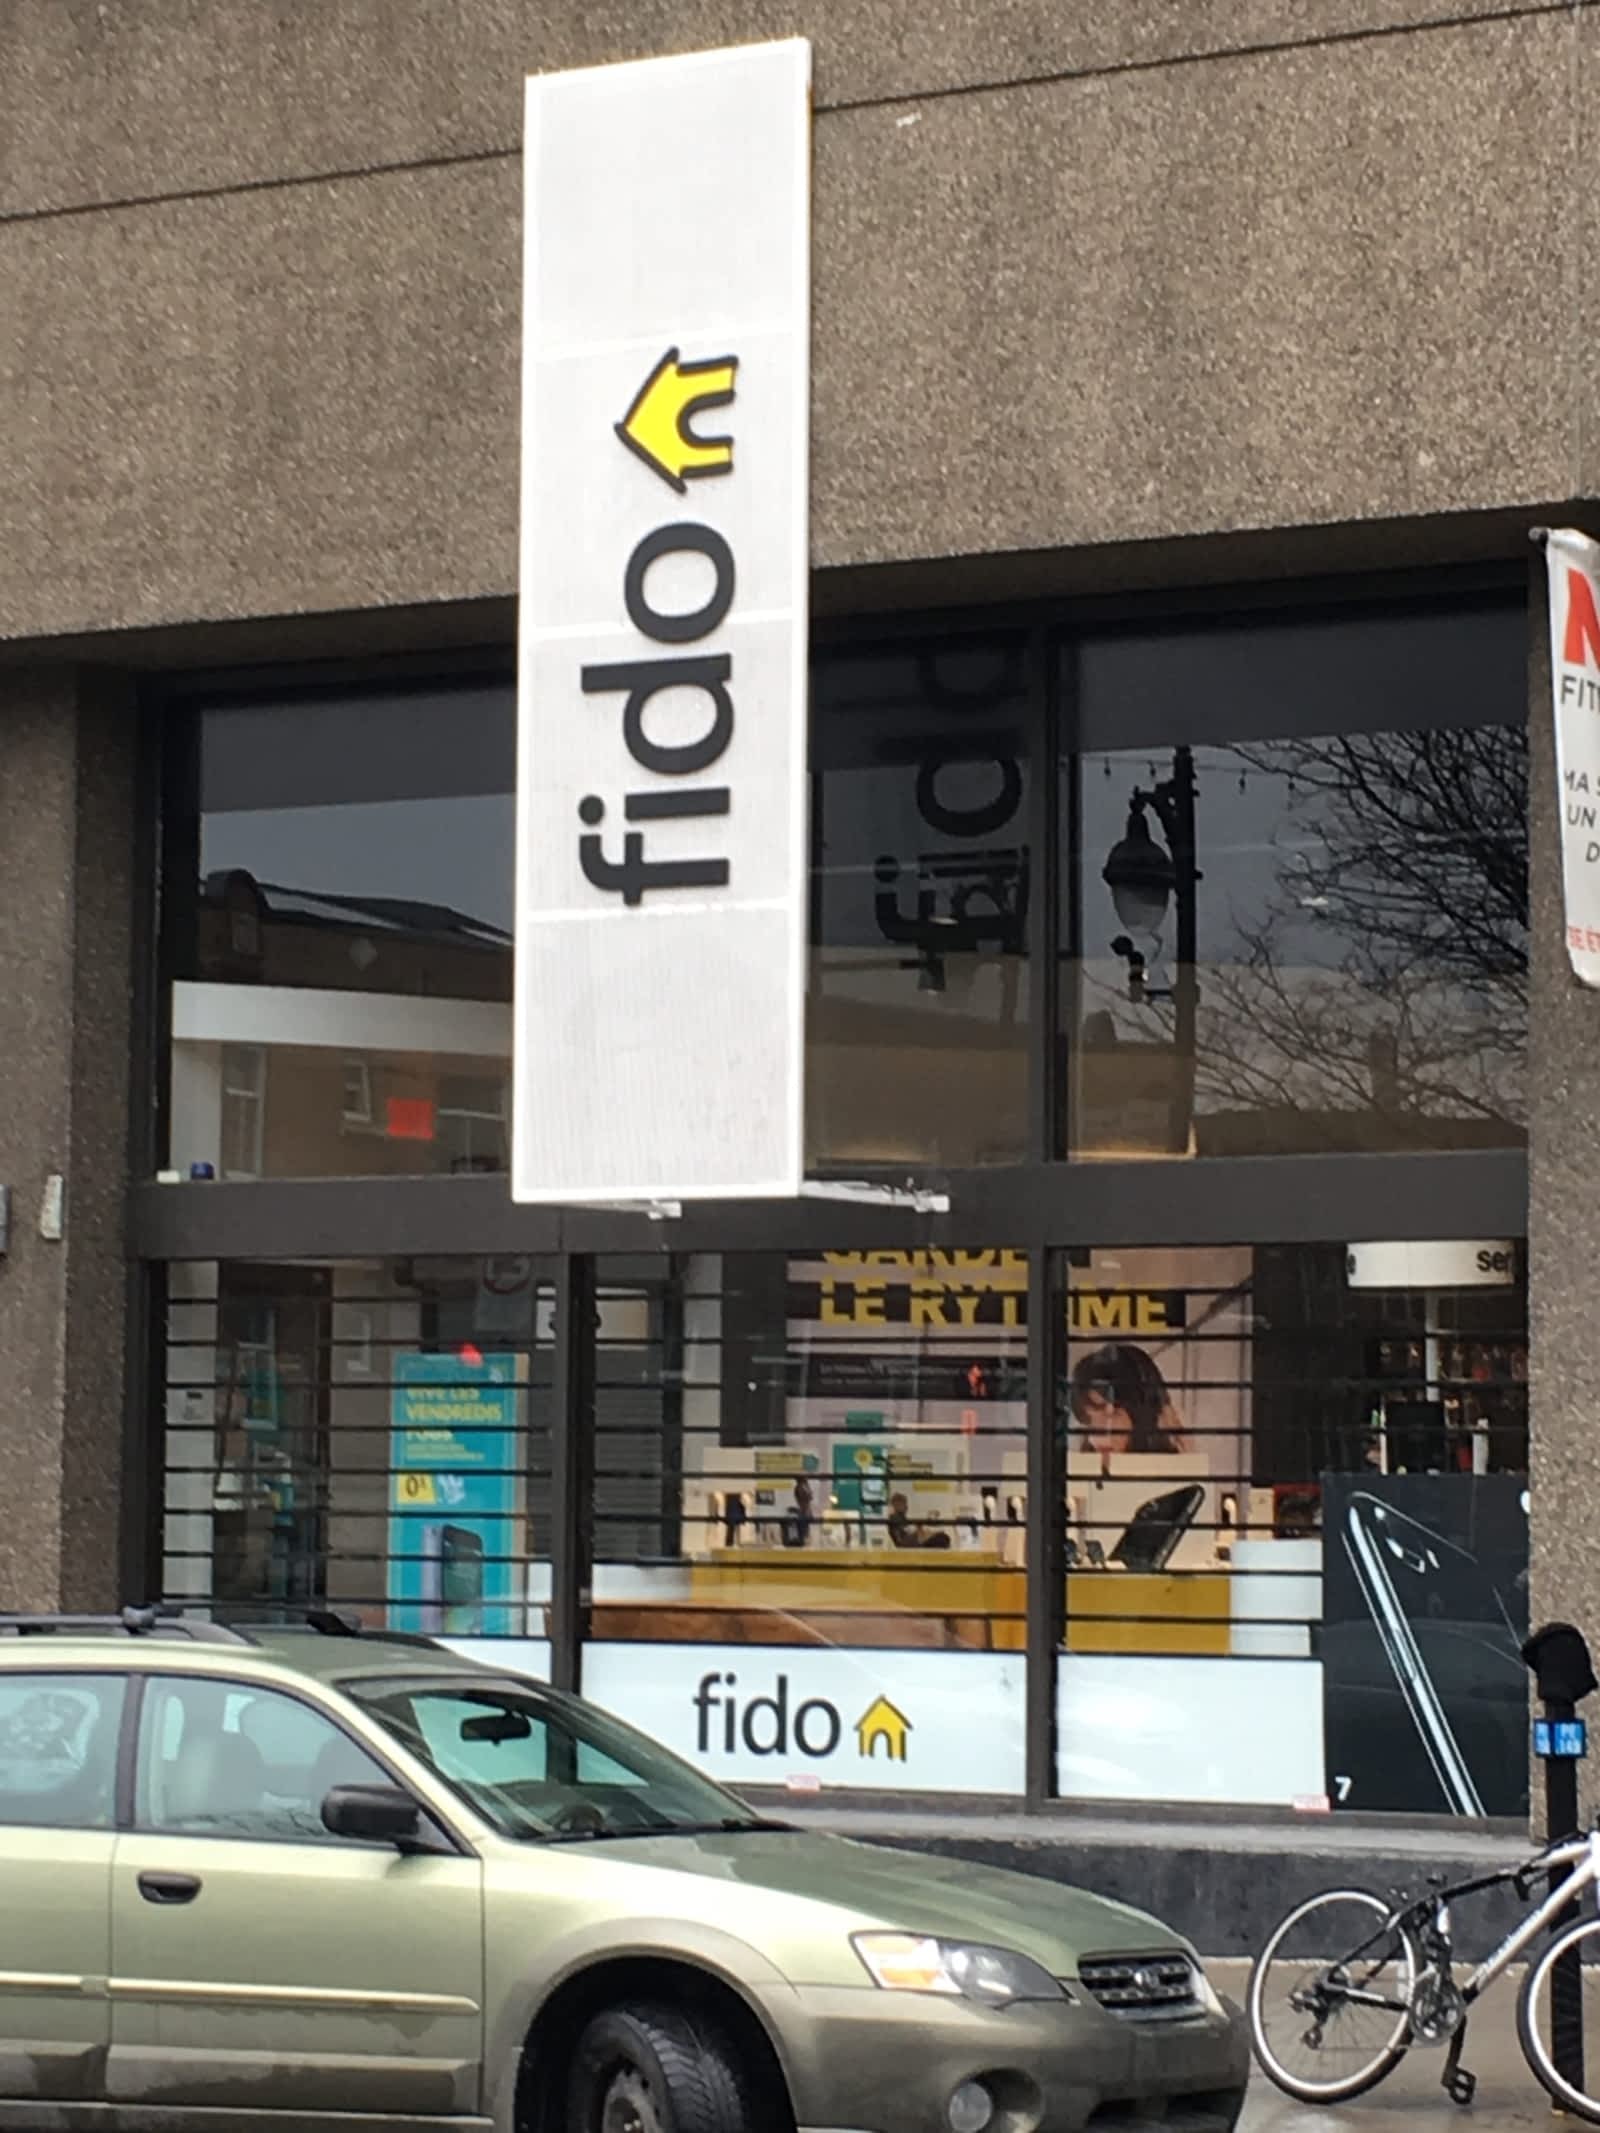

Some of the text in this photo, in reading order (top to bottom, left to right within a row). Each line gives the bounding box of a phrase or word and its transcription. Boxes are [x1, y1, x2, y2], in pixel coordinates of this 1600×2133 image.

[578, 521, 736, 906] fido
[1561, 674, 1600, 711] FIT
[1567, 803, 1597, 830] UN
[819, 1274, 1171, 1334] LE RYTME
[693, 1671, 841, 1758] fido
[1335, 1776, 1352, 1801] 7
